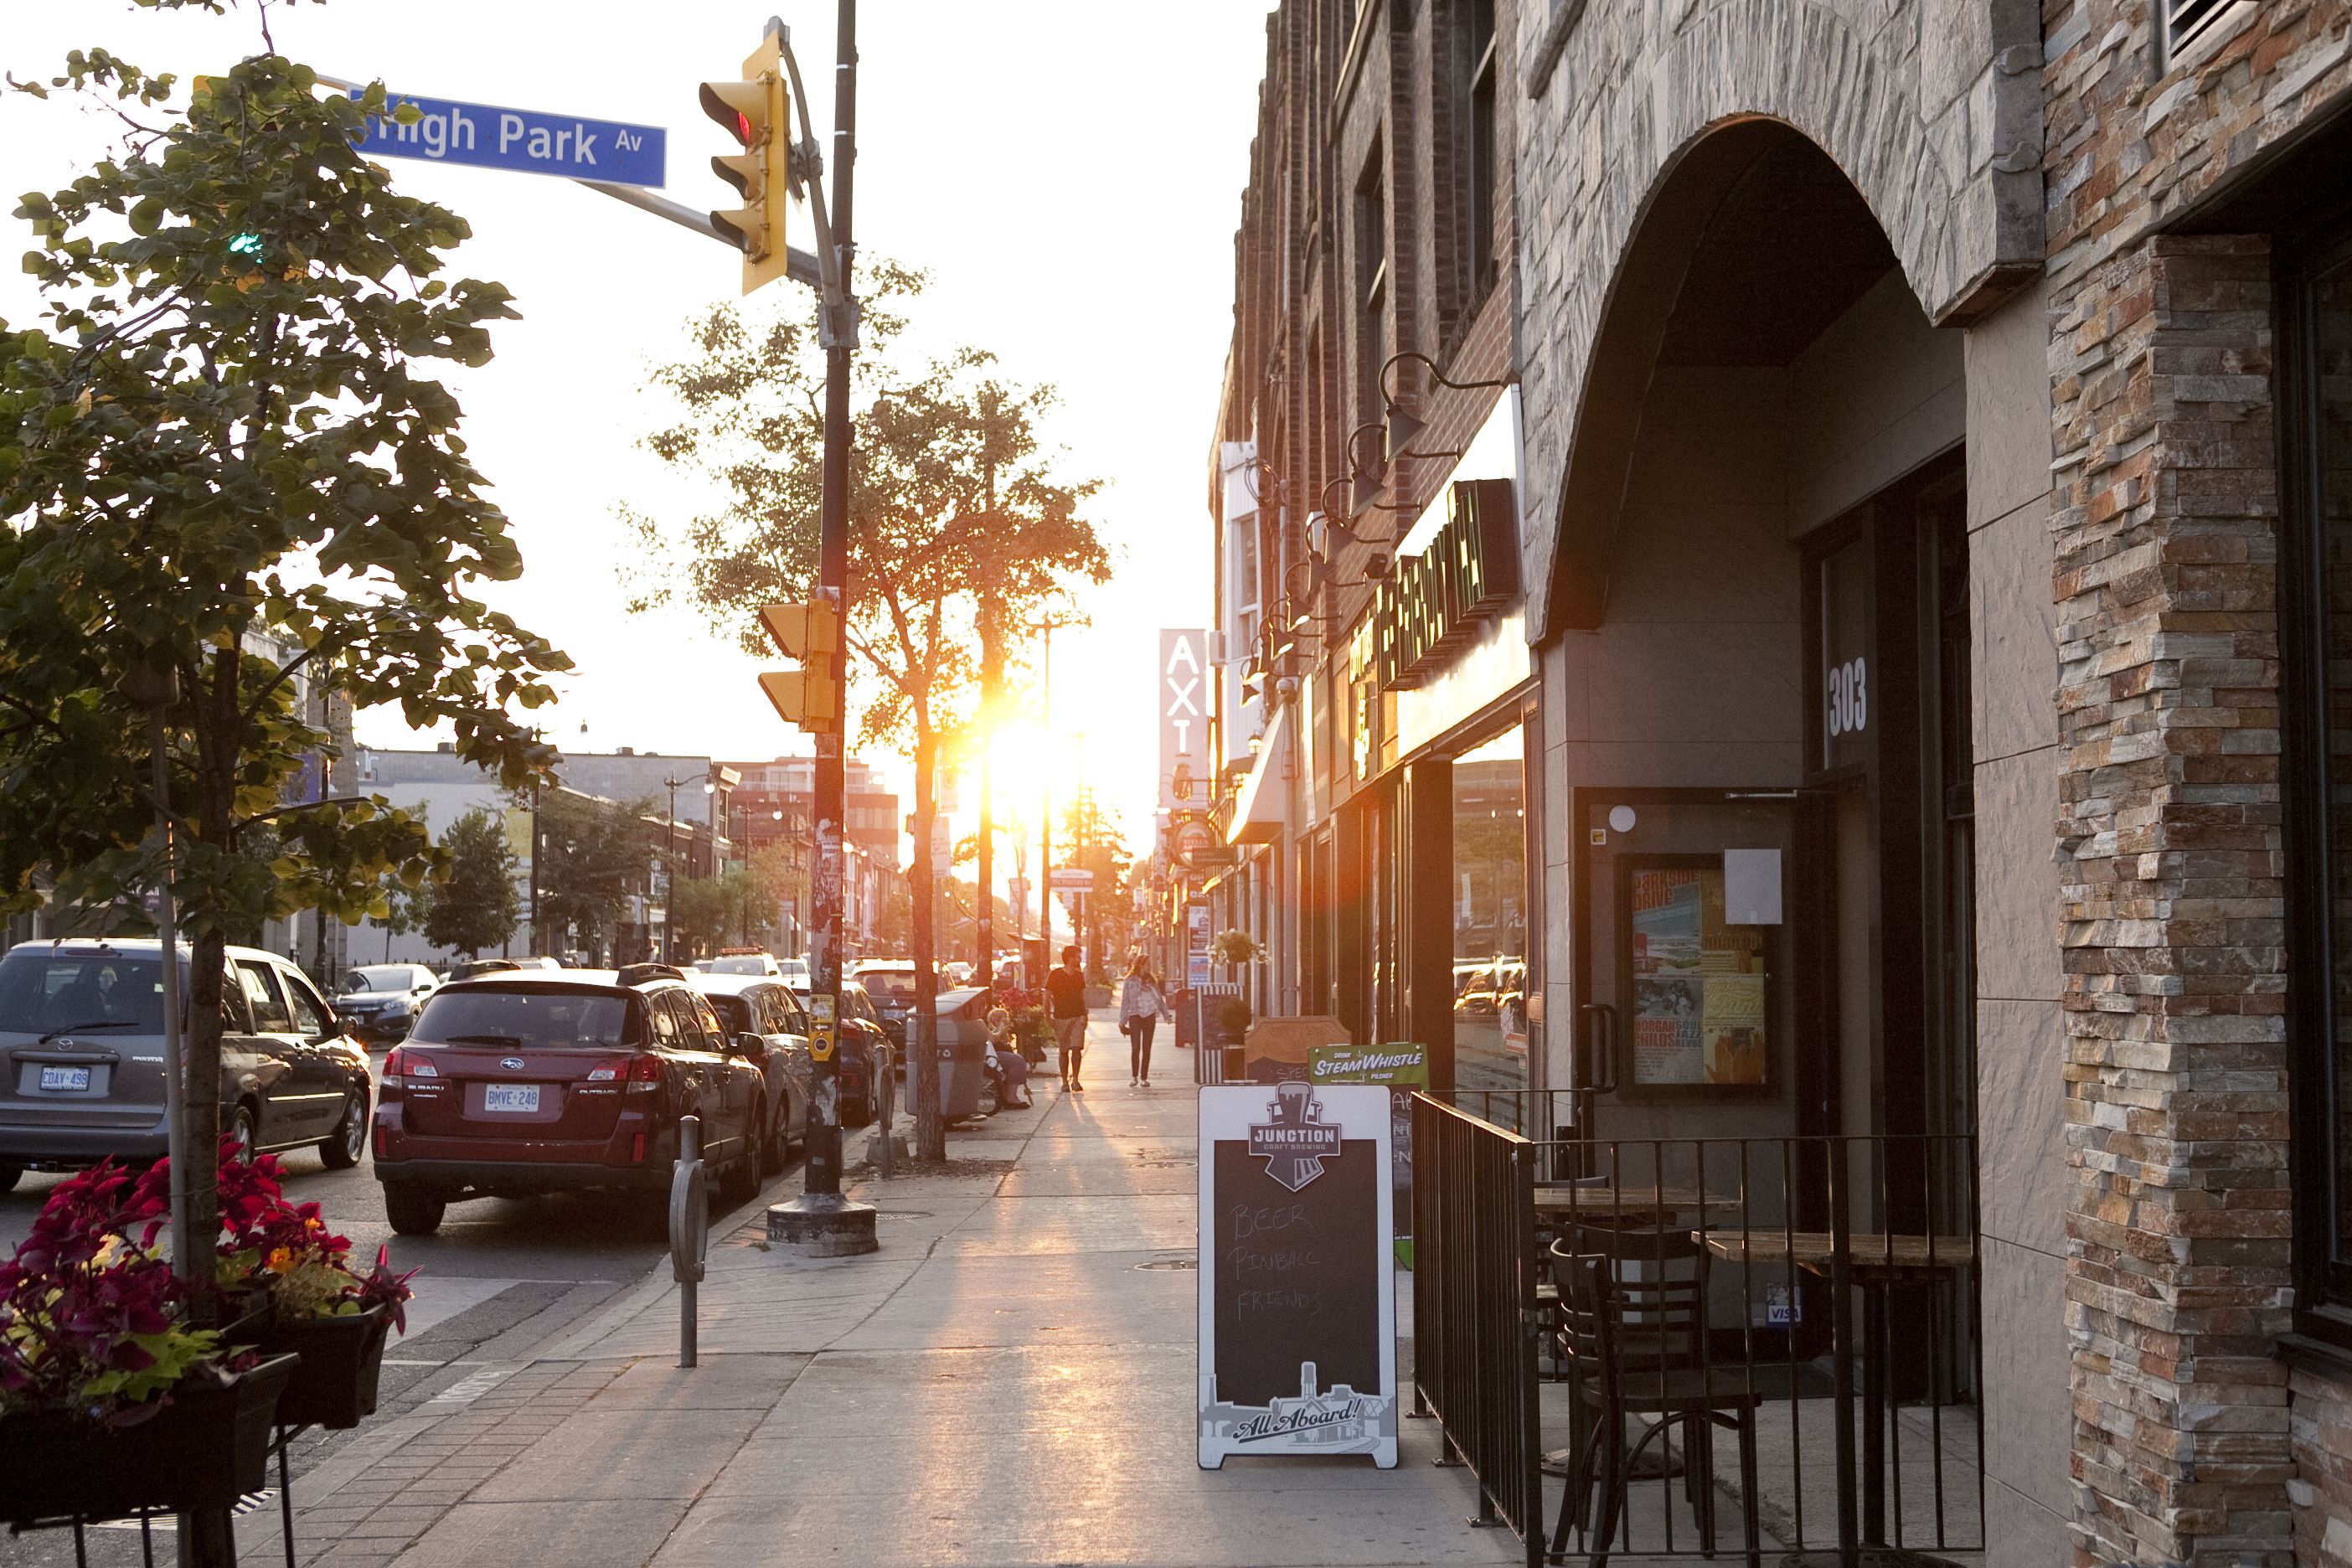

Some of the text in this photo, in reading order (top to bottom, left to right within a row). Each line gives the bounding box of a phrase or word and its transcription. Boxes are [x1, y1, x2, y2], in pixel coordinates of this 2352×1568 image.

[499, 114, 596, 165] Park
[615, 129, 642, 152] Av
[1828, 657, 1866, 737] 303
[1635, 1020, 1675, 1032] MORGAN
[1675, 1019, 1703, 1030] SOUL
[1634, 1033, 1675, 1047] CHILDS
[1675, 1039, 1703, 1048] REVUE
[70, 1073, 88, 1086] 498
[488, 1091, 538, 1106] BMVE 248
[1255, 1129, 1334, 1142] JUNCTION
[1230, 1204, 1314, 1241] BEER
[1237, 1290, 1323, 1322] FRIENDS
[1233, 1398, 1362, 1439] All Aboard!
